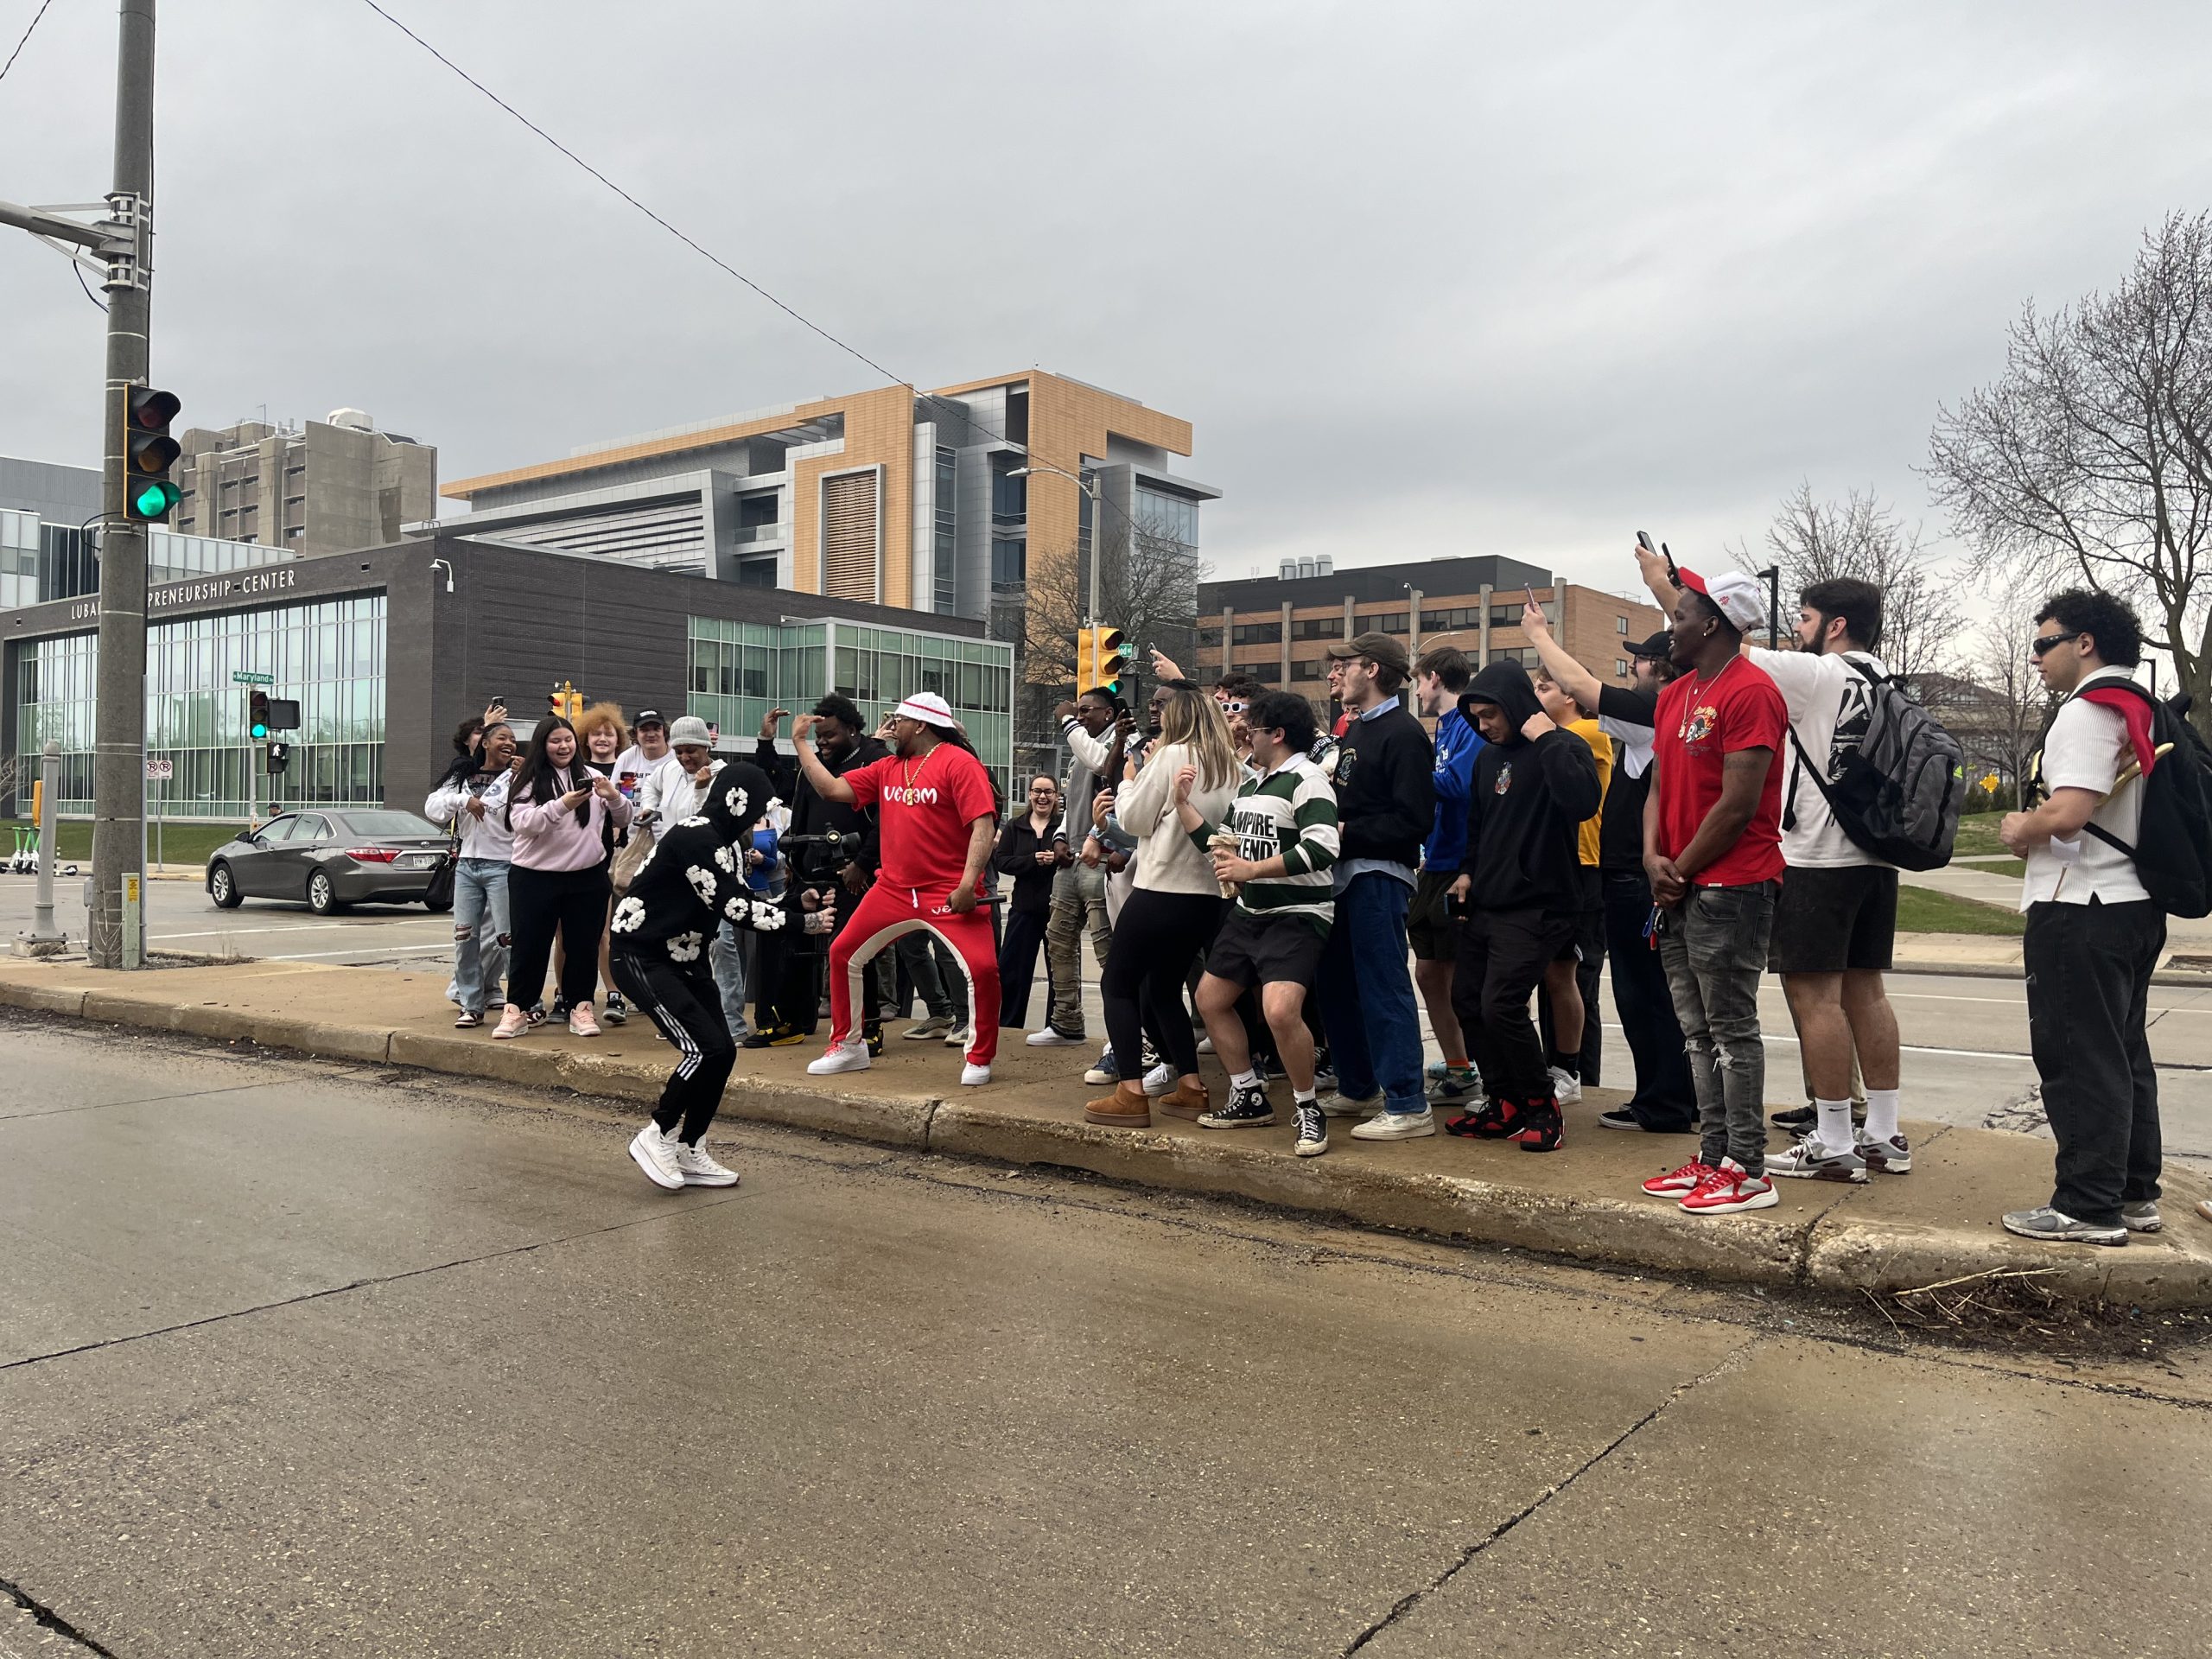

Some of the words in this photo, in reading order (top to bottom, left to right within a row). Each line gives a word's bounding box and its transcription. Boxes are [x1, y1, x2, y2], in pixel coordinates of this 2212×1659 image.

[148, 581, 231, 608] PRENEURSHIP
[243, 570, 295, 594] CENTER
[237, 672, 270, 683] Maryland
[1231, 811, 1274, 837] AMPIRE
[1236, 836, 1278, 862] KEND'
